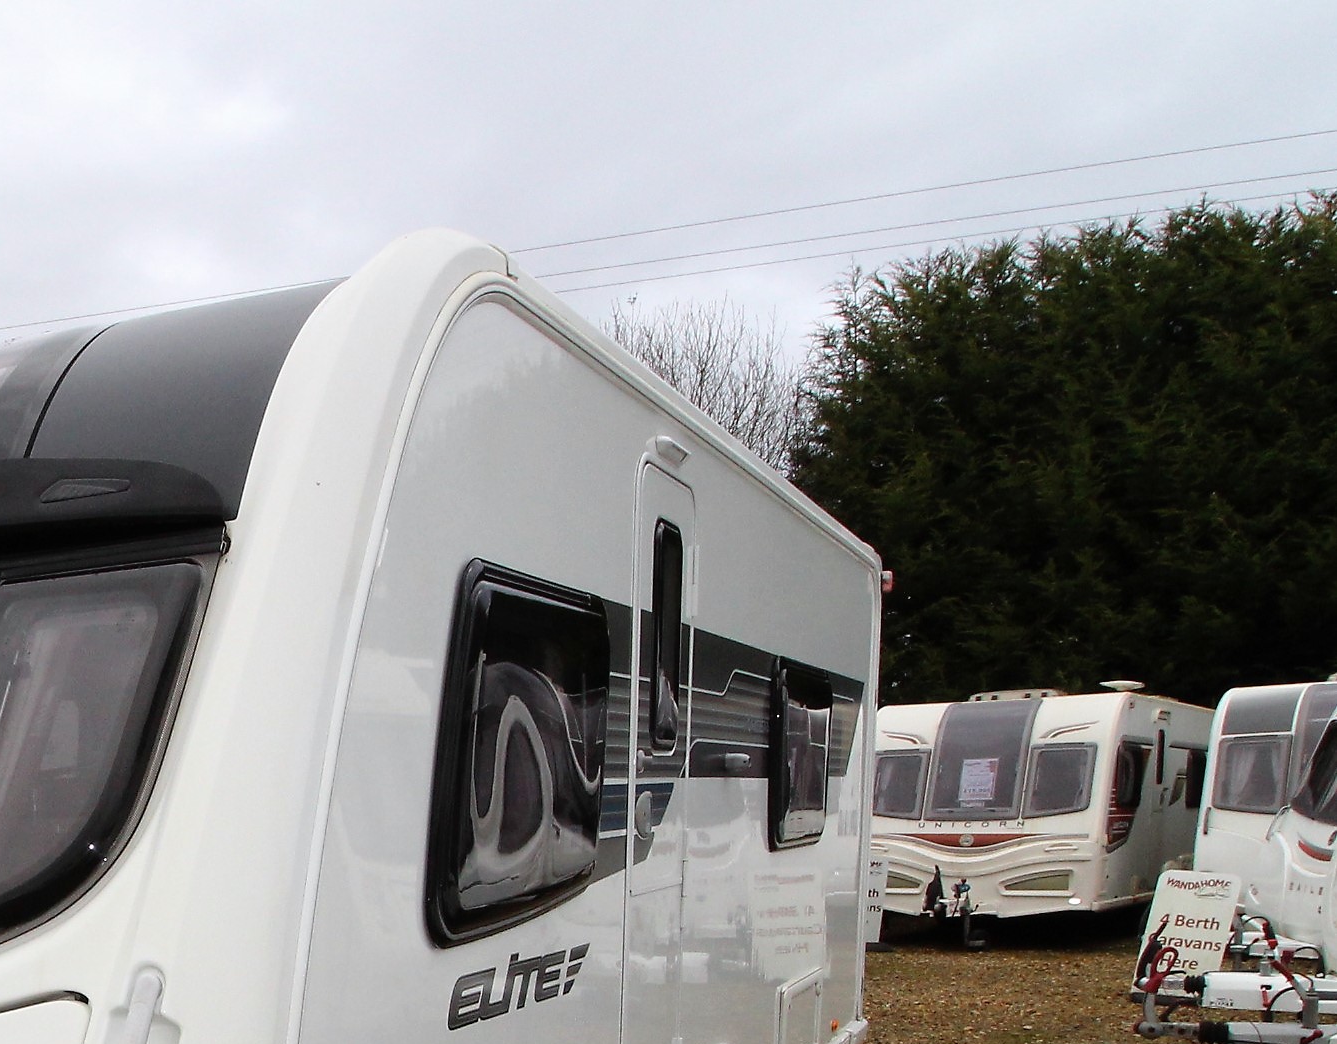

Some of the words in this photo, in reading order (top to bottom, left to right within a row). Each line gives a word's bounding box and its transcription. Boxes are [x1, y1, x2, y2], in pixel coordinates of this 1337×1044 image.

[918, 820, 1025, 829] UNICORN
[1159, 913, 1170, 925] 4
[1174, 914, 1220, 931] Berth
[1160, 935, 1222, 952] aravans
